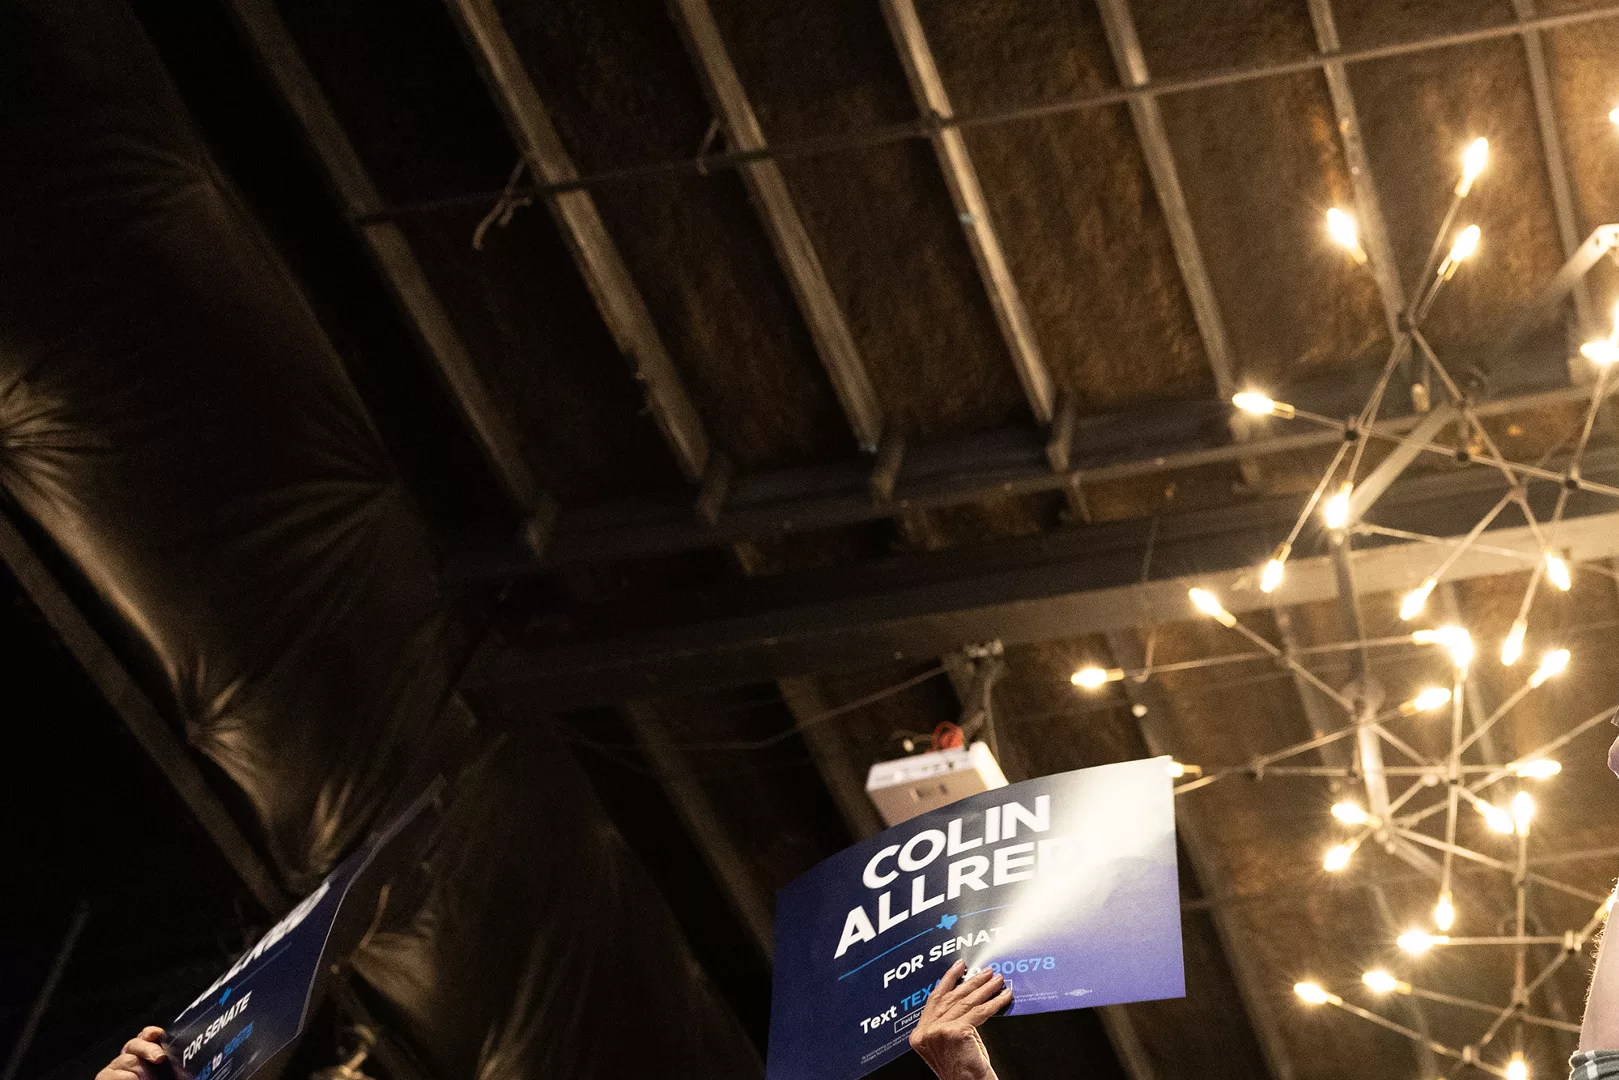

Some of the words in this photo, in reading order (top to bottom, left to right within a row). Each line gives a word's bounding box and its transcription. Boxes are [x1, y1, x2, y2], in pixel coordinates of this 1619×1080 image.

[862, 794, 1050, 889] COLIN
[860, 1005, 898, 1034] Text
[900, 979, 941, 1012] TEX
[988, 956, 1056, 975] 90678
[883, 954, 924, 989] FOR
[929, 924, 1022, 962] SENAT
[183, 1034, 203, 1068] FOR
[203, 990, 253, 1045] SENATE
